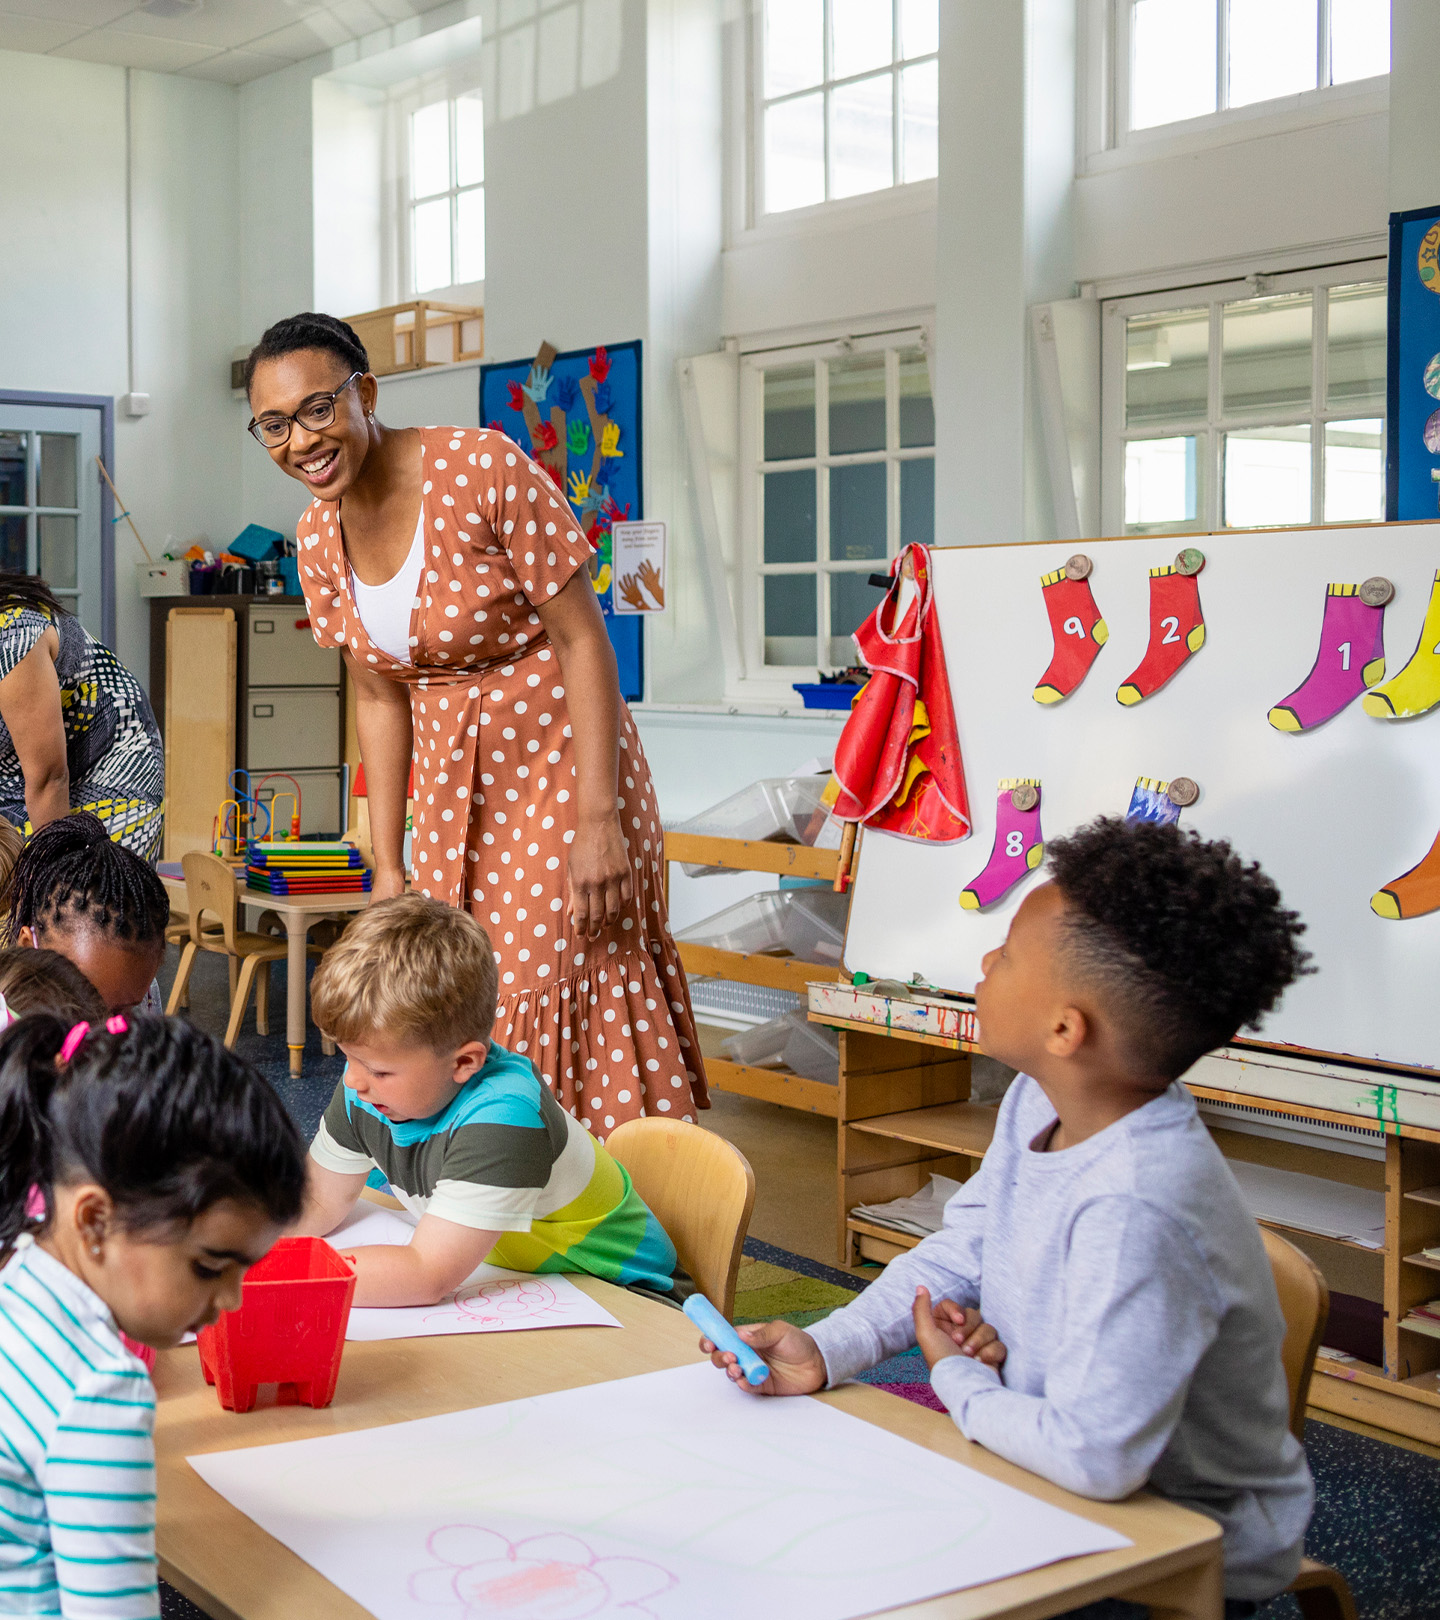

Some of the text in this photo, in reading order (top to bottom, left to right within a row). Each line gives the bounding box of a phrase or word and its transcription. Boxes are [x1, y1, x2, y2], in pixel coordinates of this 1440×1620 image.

[1063, 616, 1086, 639] 9
[1160, 616, 1181, 645] 2
[1337, 642, 1352, 671] 1
[1005, 830, 1025, 858] 8
